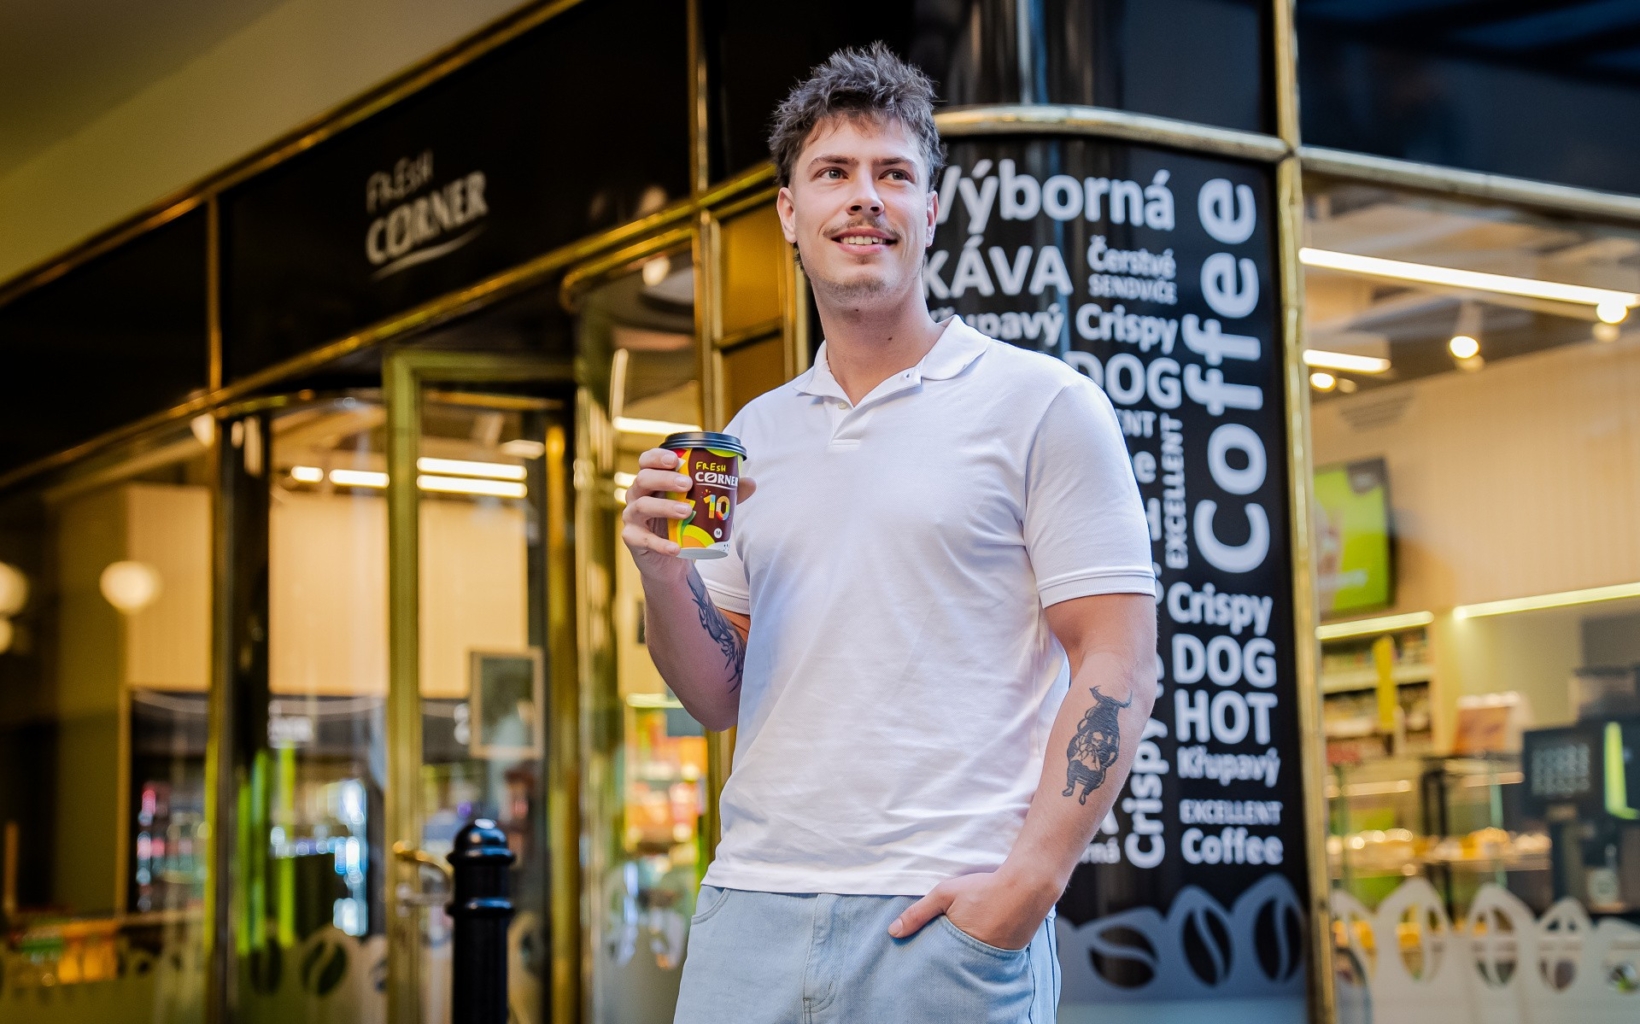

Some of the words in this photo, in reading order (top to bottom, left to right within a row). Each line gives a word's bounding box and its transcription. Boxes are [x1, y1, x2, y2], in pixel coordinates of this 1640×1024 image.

[922, 234, 1074, 299] KÁVA
[1087, 235, 1177, 281] Čerstvé
[1075, 303, 1179, 355] Crispy
[1062, 351, 1182, 410] DOG
[1181, 177, 1270, 574] Coffee
[695, 461, 727, 472] FRESH
[1160, 412, 1189, 569] EXCELLENT
[703, 494, 731, 521] 10
[1167, 581, 1273, 636] Crispy
[1171, 633, 1277, 688] DOG
[1174, 688, 1278, 744] HOT
[1177, 745, 1281, 788] Křupavý
[1179, 799, 1283, 826] EXCELLENT
[1181, 827, 1284, 865] Coffee
